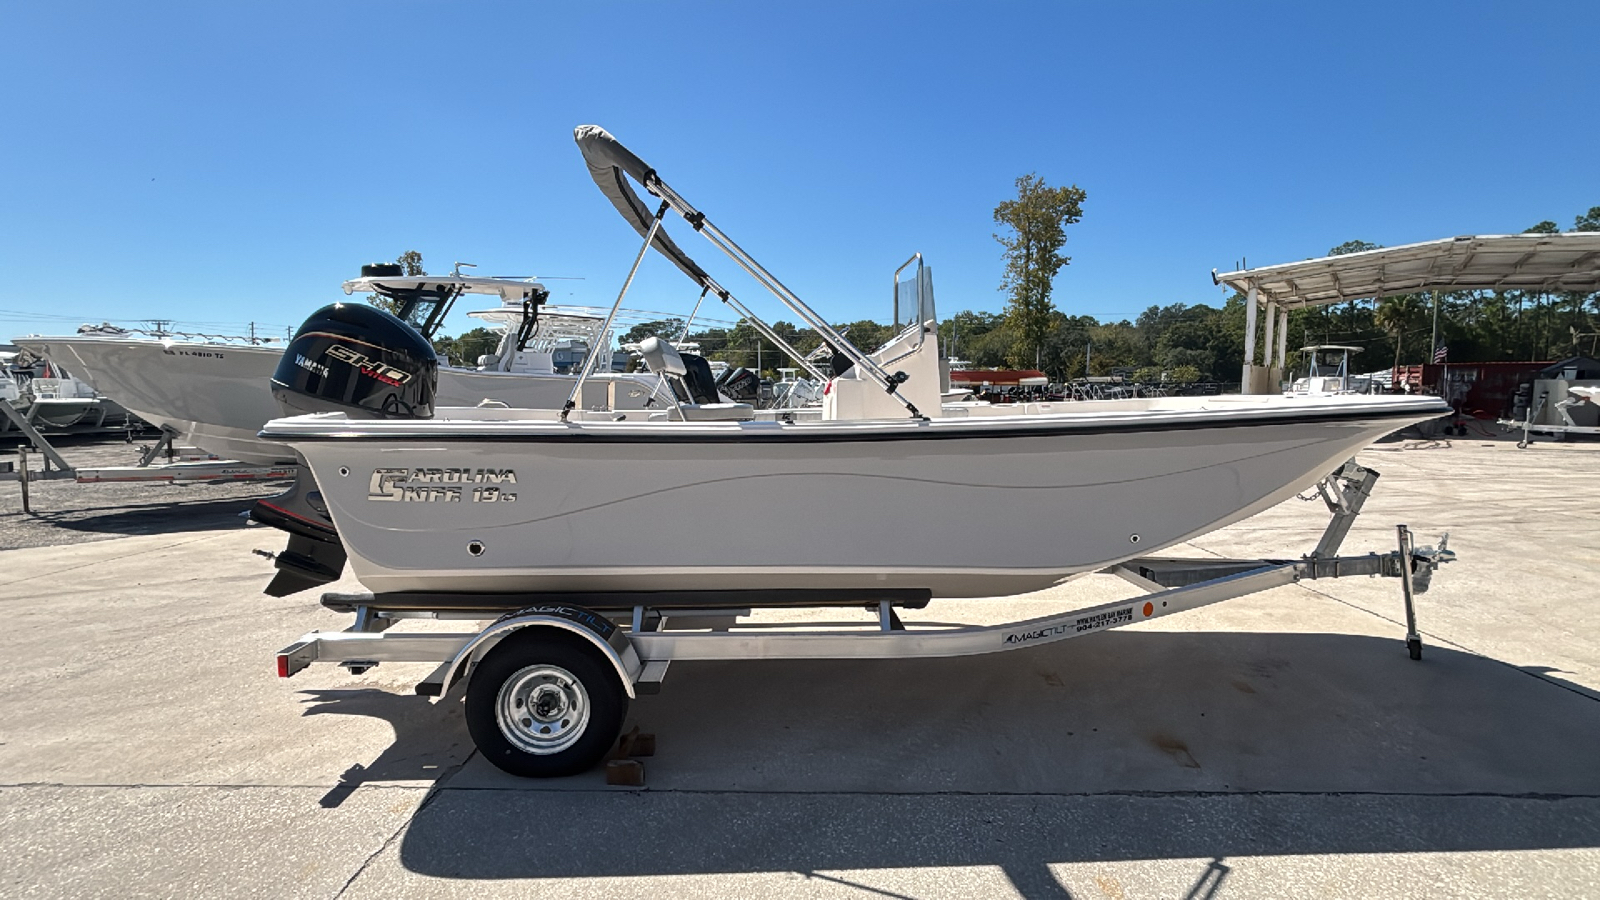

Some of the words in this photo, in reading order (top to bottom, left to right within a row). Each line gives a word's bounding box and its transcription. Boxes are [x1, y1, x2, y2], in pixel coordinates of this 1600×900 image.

[294, 353, 330, 379] YAMAHA
[324, 344, 413, 385] SHO
[369, 467, 518, 490] CAROLINA
